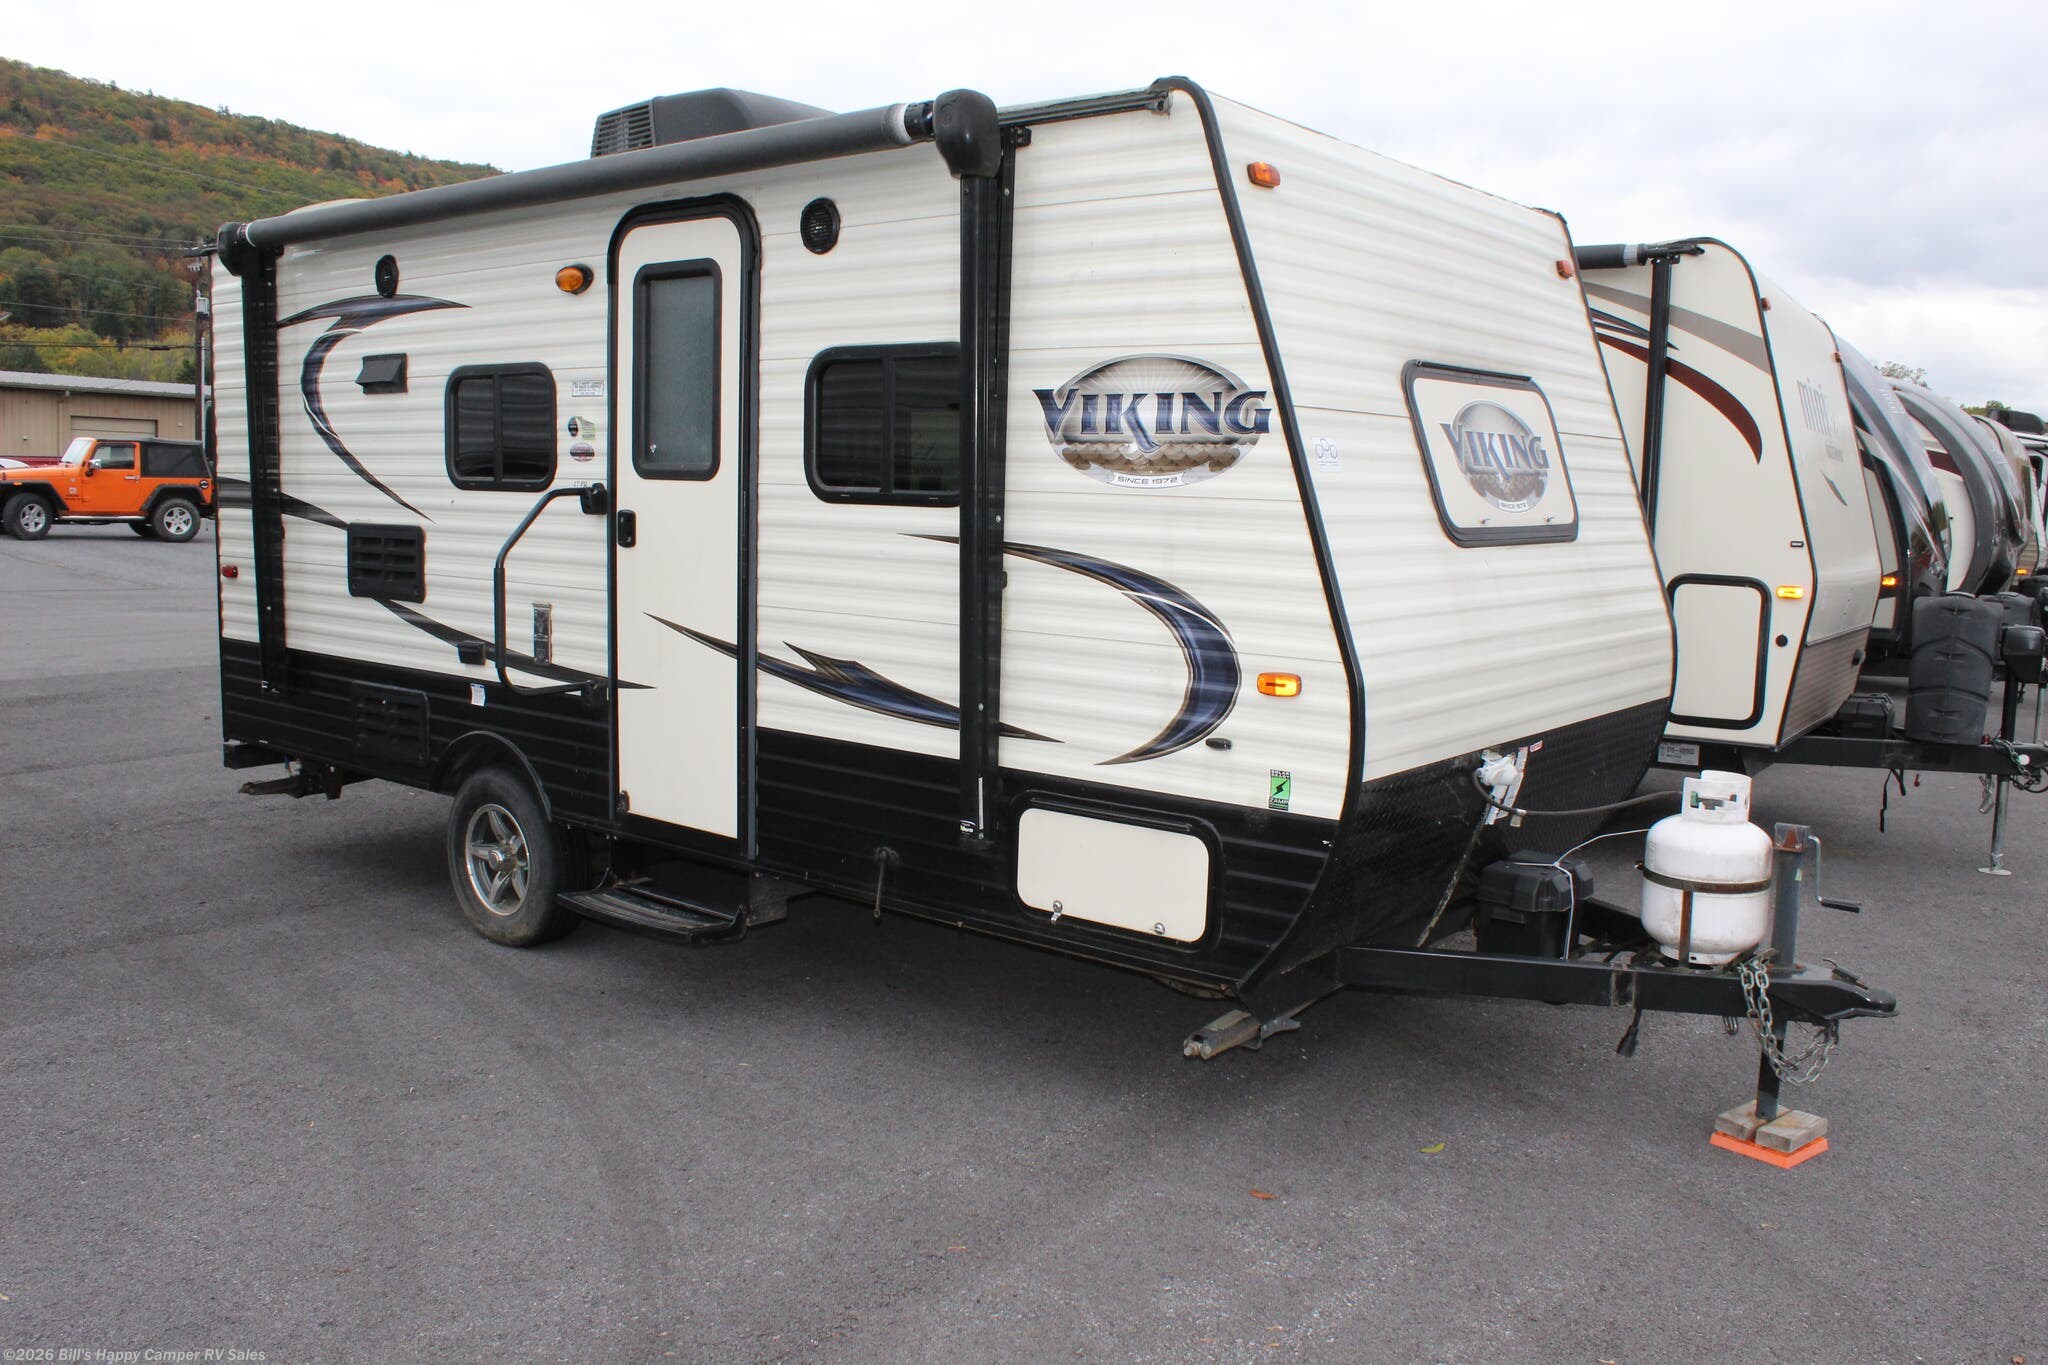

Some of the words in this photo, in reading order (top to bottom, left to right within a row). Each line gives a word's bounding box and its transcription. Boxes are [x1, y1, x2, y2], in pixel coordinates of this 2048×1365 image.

[1032, 388, 1272, 453] VIKING
[1118, 476, 1149, 484] SINCE
[1152, 476, 1178, 484] 1972
[1440, 423, 1550, 481] VIKING
